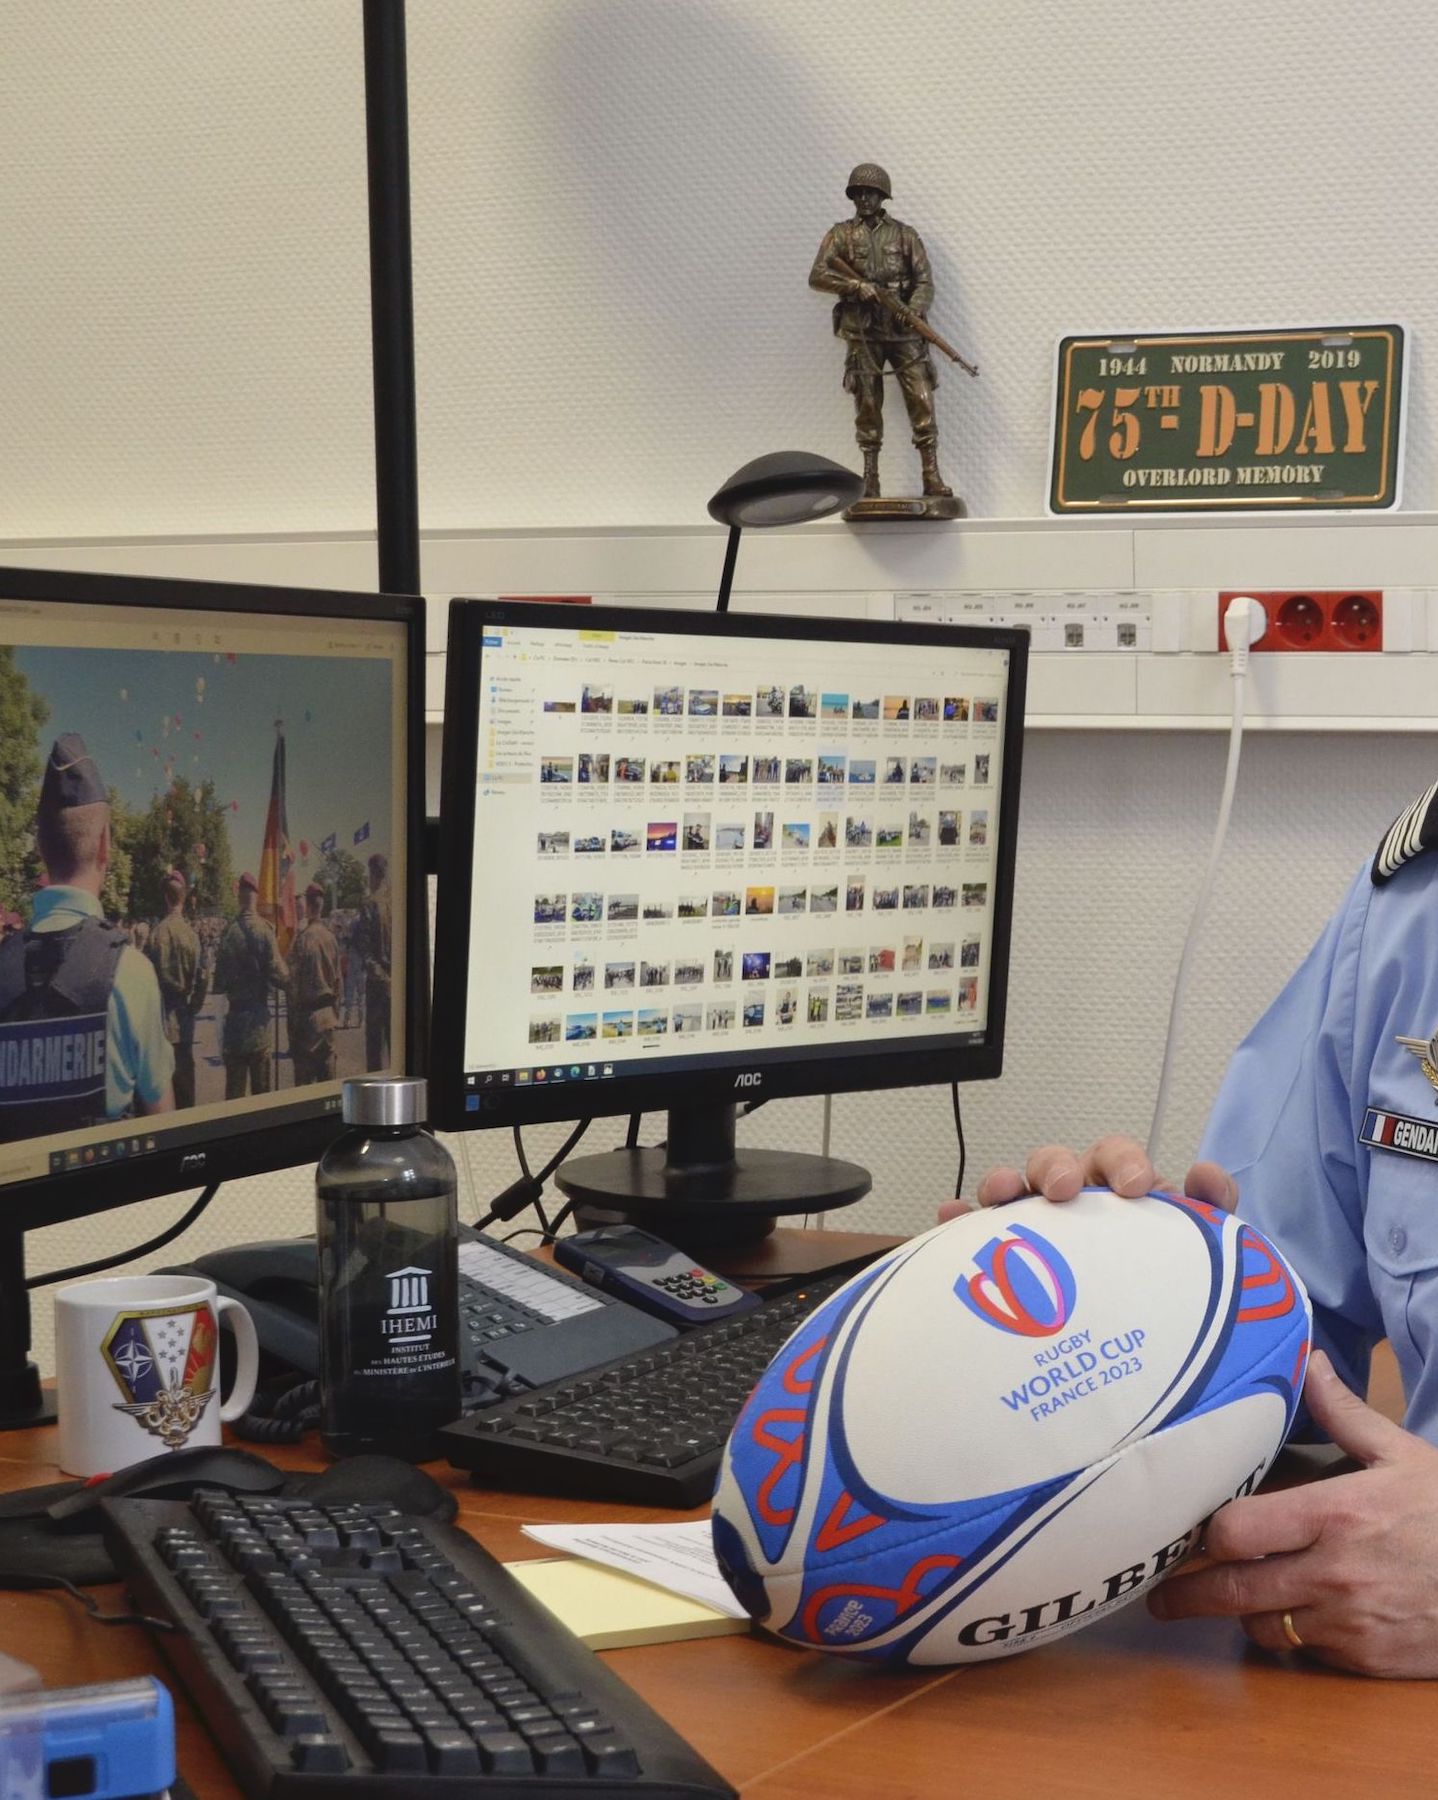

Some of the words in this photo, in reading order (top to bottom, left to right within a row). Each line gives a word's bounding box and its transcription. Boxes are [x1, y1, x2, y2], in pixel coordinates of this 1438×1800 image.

[1099, 357, 1148, 377] 1944
[1171, 352, 1286, 375] NORMANDY
[1307, 350, 1361, 370] 2019
[1196, 380, 1380, 458] D-DAY
[1122, 468, 1231, 487] OVERLORD
[1236, 465, 1325, 486] MEMORY
[734, 1072, 762, 1088] AOC
[381, 1314, 438, 1334] IHEMI
[383, 1355, 418, 1365] HAUTES
[391, 1343, 430, 1354] INSTITUT
[1033, 1329, 1092, 1367] RUGBY
[1000, 1352, 1098, 1411] WORLD
[1100, 1329, 1146, 1360] CUP
[1030, 1376, 1098, 1422] FRANCE
[1098, 1357, 1143, 1386] 2023
[957, 1457, 1267, 1648] GILBET
